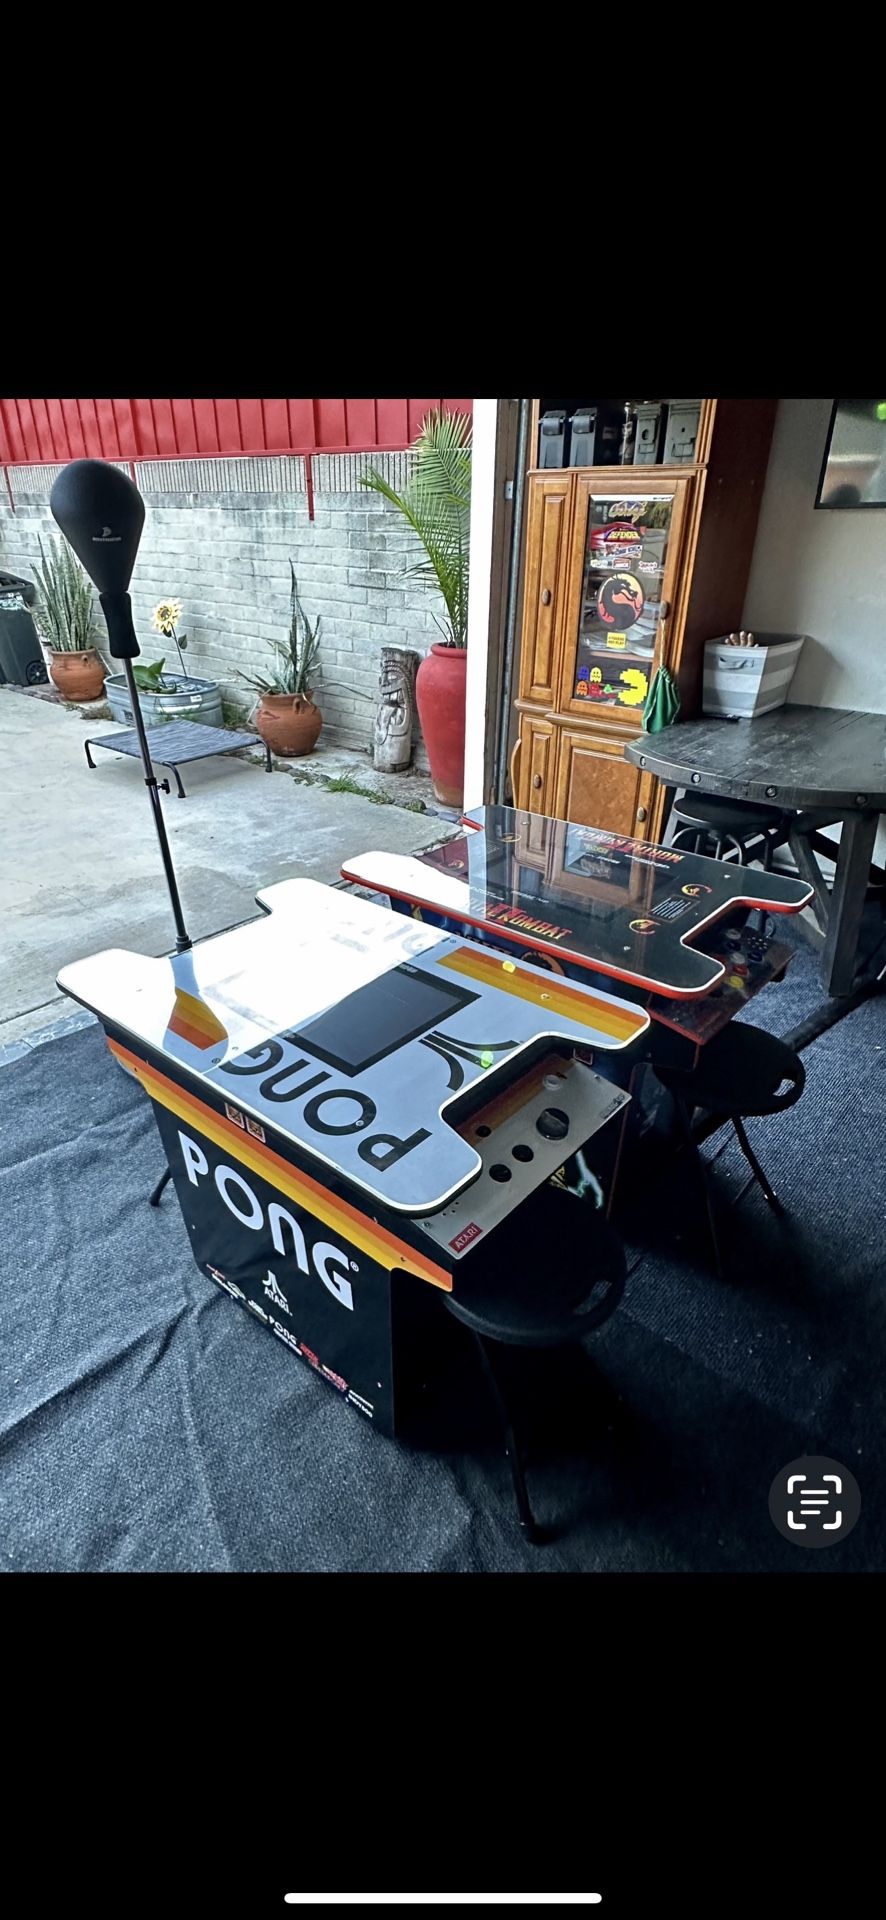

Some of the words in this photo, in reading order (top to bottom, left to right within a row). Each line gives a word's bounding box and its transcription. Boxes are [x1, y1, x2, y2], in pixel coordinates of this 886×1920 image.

[497, 905, 573, 940] KOMBAT
[218, 1039, 433, 1172] PONG
[454, 1226, 478, 1248] ATARI
[264, 1286, 291, 1315] ATARI
